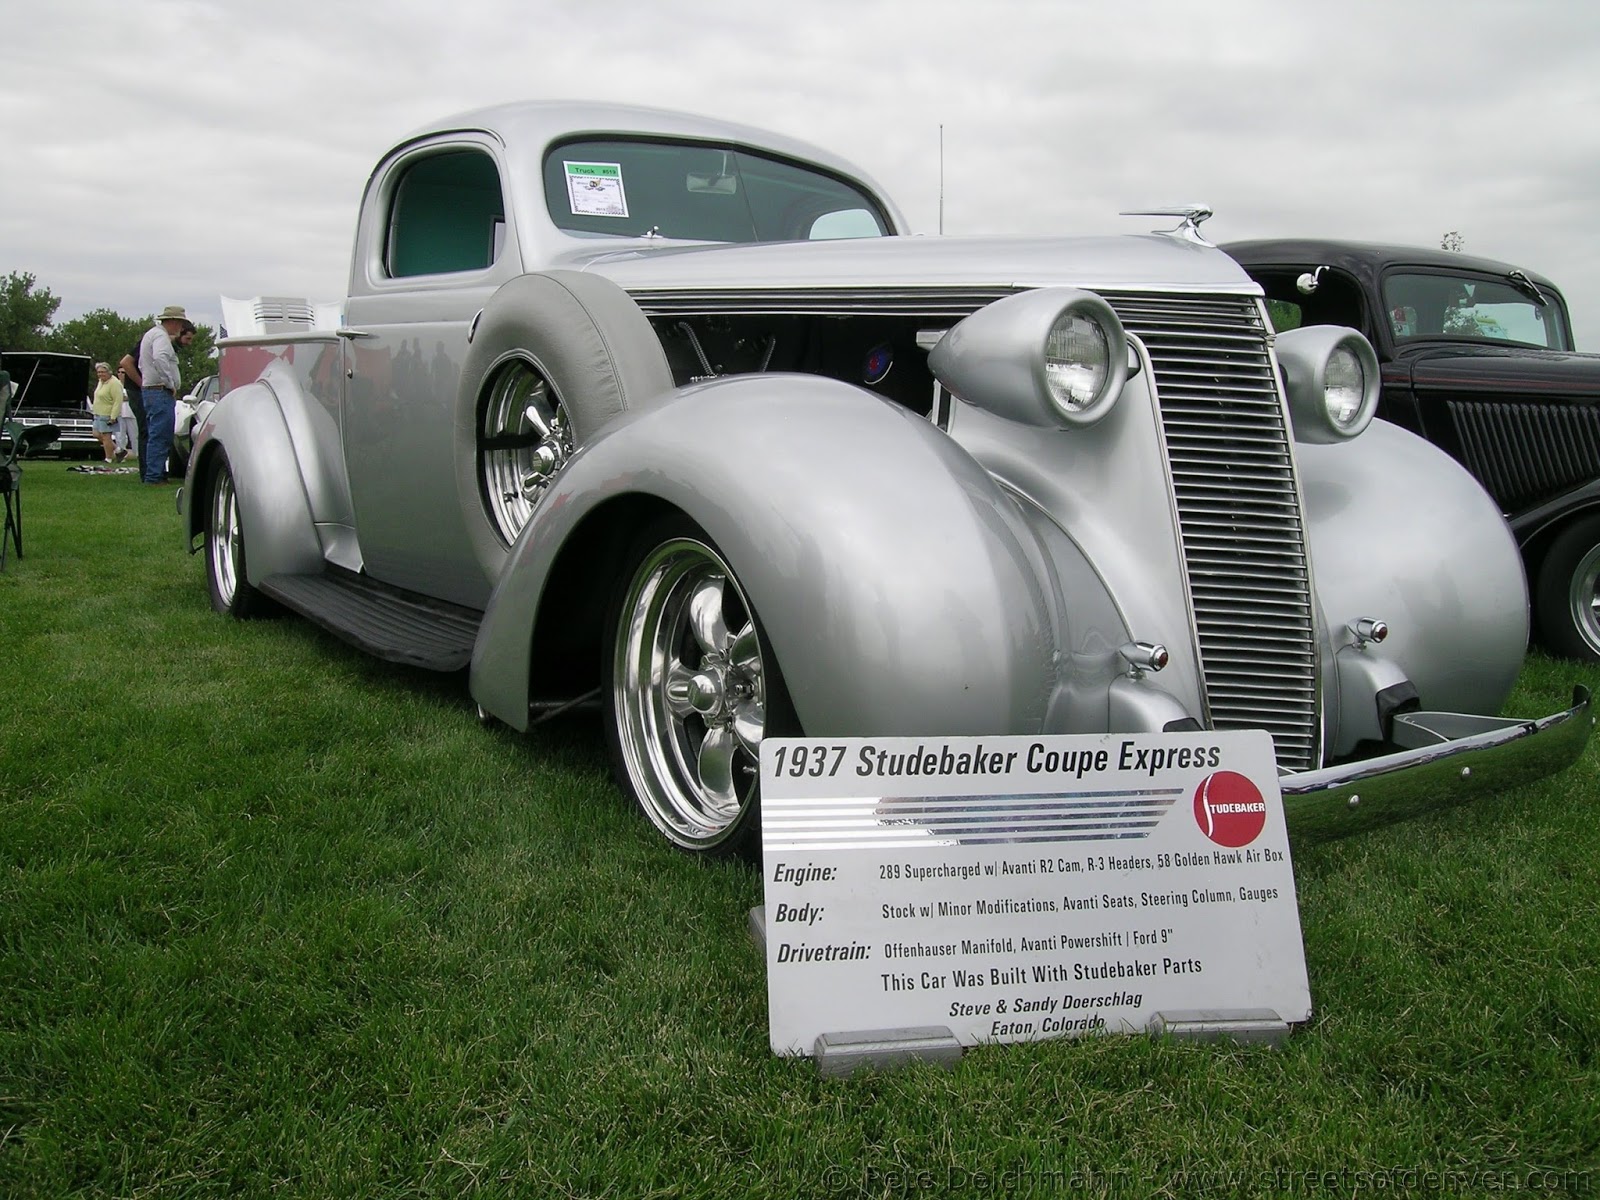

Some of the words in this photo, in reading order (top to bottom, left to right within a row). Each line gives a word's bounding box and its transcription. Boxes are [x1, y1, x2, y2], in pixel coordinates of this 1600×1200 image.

[774, 746, 847, 777] 1937
[856, 744, 1018, 777] Studebaker
[1026, 743, 1108, 779] Coupe
[1118, 741, 1220, 777] Express
[773, 863, 837, 886] Engine:
[879, 864, 901, 880] 289
[905, 861, 981, 882] Supercharged
[1001, 859, 1037, 876] Avanti
[1040, 859, 1054, 874] R2
[1058, 858, 1084, 874] Cam,
[1087, 856, 1105, 871] R-3
[1109, 855, 1154, 870] Headers,
[1157, 853, 1171, 868] 58
[1175, 852, 1210, 867] Golden
[1214, 850, 1243, 865] Hawk
[1246, 849, 1261, 863] Air
[1264, 848, 1284, 862] Box
[775, 903, 825, 926] Body:
[882, 903, 916, 919] Stock
[938, 900, 972, 917] Minor
[976, 897, 1059, 915] Modifications,
[1063, 895, 1099, 911] Avanti
[1102, 893, 1138, 909] Seats,
[1141, 890, 1189, 908] Steering
[1191, 888, 1236, 904] Column,
[1239, 886, 1279, 902] Gauges
[777, 940, 871, 963] Drivetrain:
[884, 941, 957, 959] Offenhauser
[961, 937, 1017, 955] Manifold,
[1021, 935, 1057, 951] Avanti
[1061, 931, 1123, 949] Powershift
[1133, 929, 1158, 946] Ford
[1160, 928, 1173, 944] 9"
[881, 972, 915, 992] This
[921, 970, 947, 990] Car
[952, 969, 985, 988] Was
[990, 965, 1027, 986] Built
[1032, 963, 1068, 983] With
[1073, 958, 1157, 981] Studebaker
[1163, 957, 1202, 975] Parts
[949, 1000, 991, 1017] Steve
[996, 998, 1008, 1014] &
[1013, 995, 1058, 1015] Sandy
[1062, 990, 1142, 1010] Doerschlag
[990, 1020, 1038, 1037] Eaton,
[1041, 1015, 1105, 1033] Colorado
